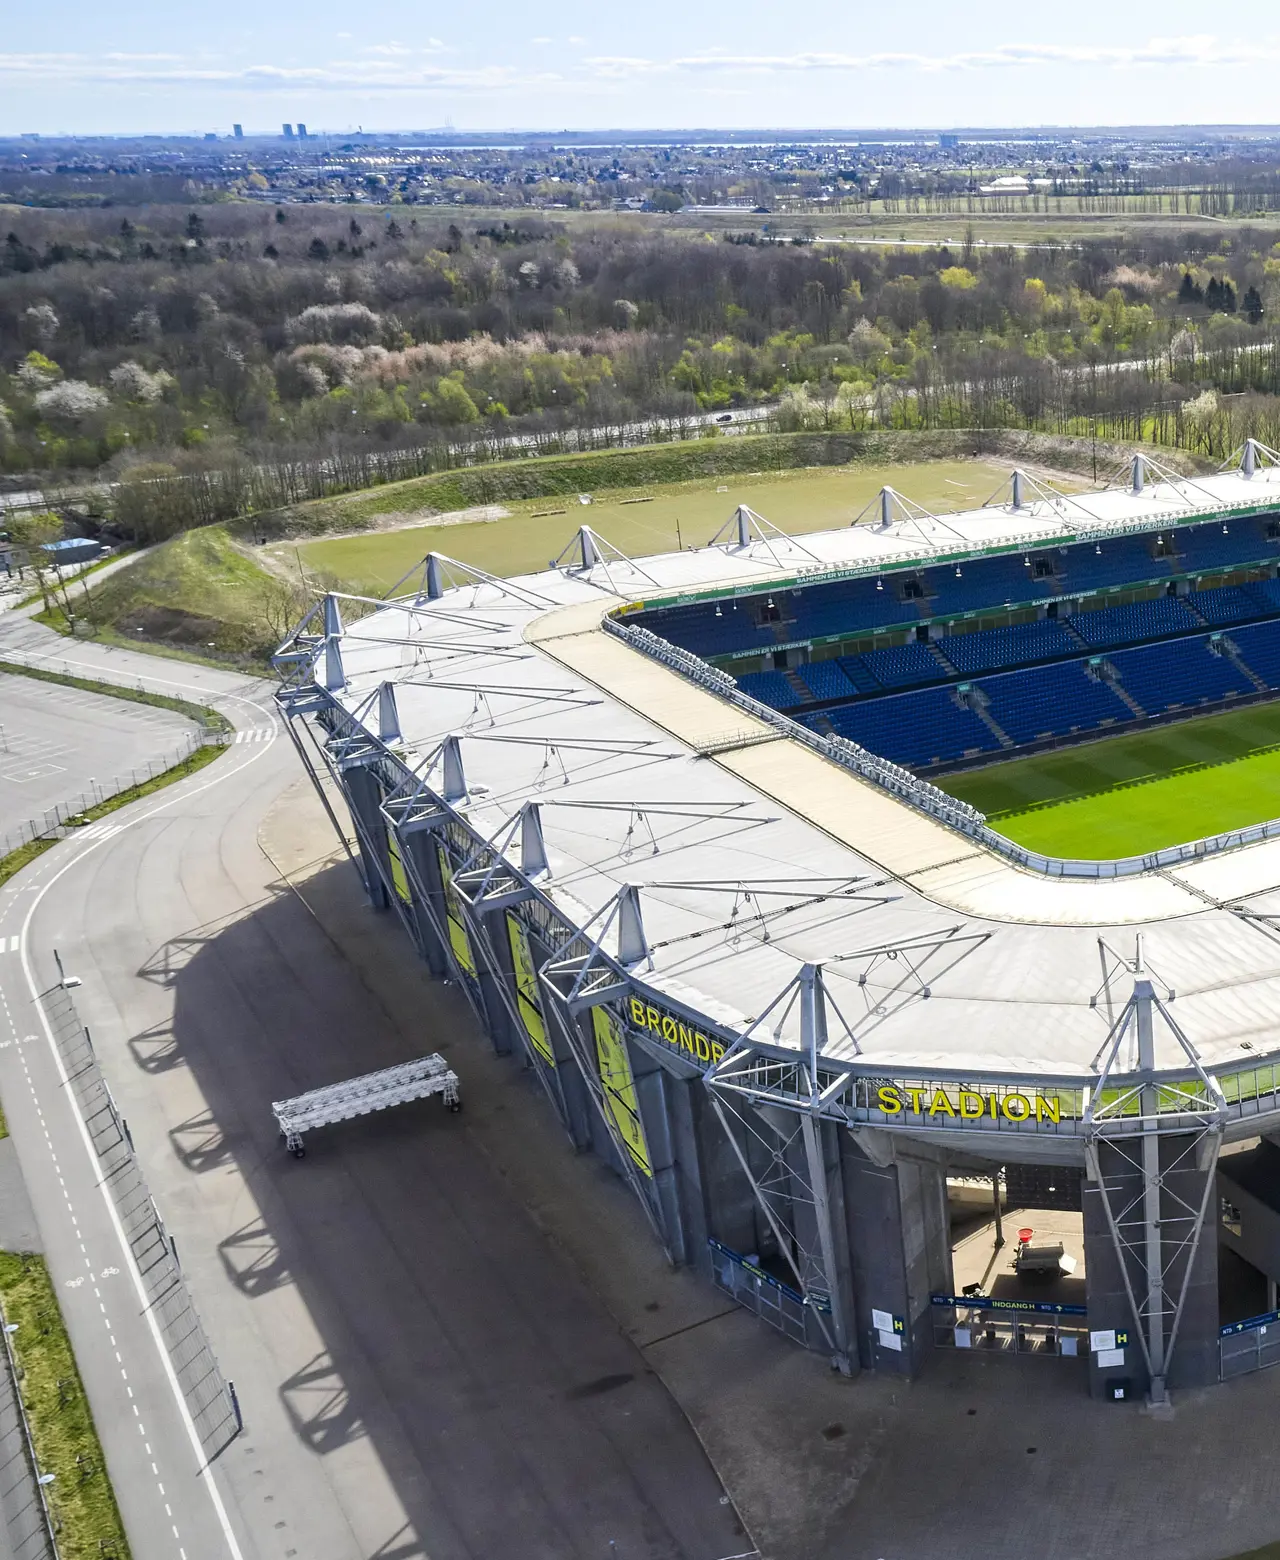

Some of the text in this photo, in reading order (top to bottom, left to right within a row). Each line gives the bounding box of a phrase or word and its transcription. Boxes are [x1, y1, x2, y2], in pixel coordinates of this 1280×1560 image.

[1075, 529, 1112, 541] SAMMEN
[1134, 518, 1179, 531] STÆRKERE
[797, 574, 827, 584] SAMMEN
[844, 566, 881, 576] STÆRKERE
[732, 649, 760, 659] SAMMEN
[760, 647, 770, 655] ER
[777, 640, 812, 652] STÆRKERE
[630, 998, 725, 1065] BRØNDB
[877, 1086, 1060, 1124] STADION
[992, 1301, 1028, 1309] INDGANG
[894, 1320, 903, 1331] H
[1117, 1333, 1127, 1344] H
